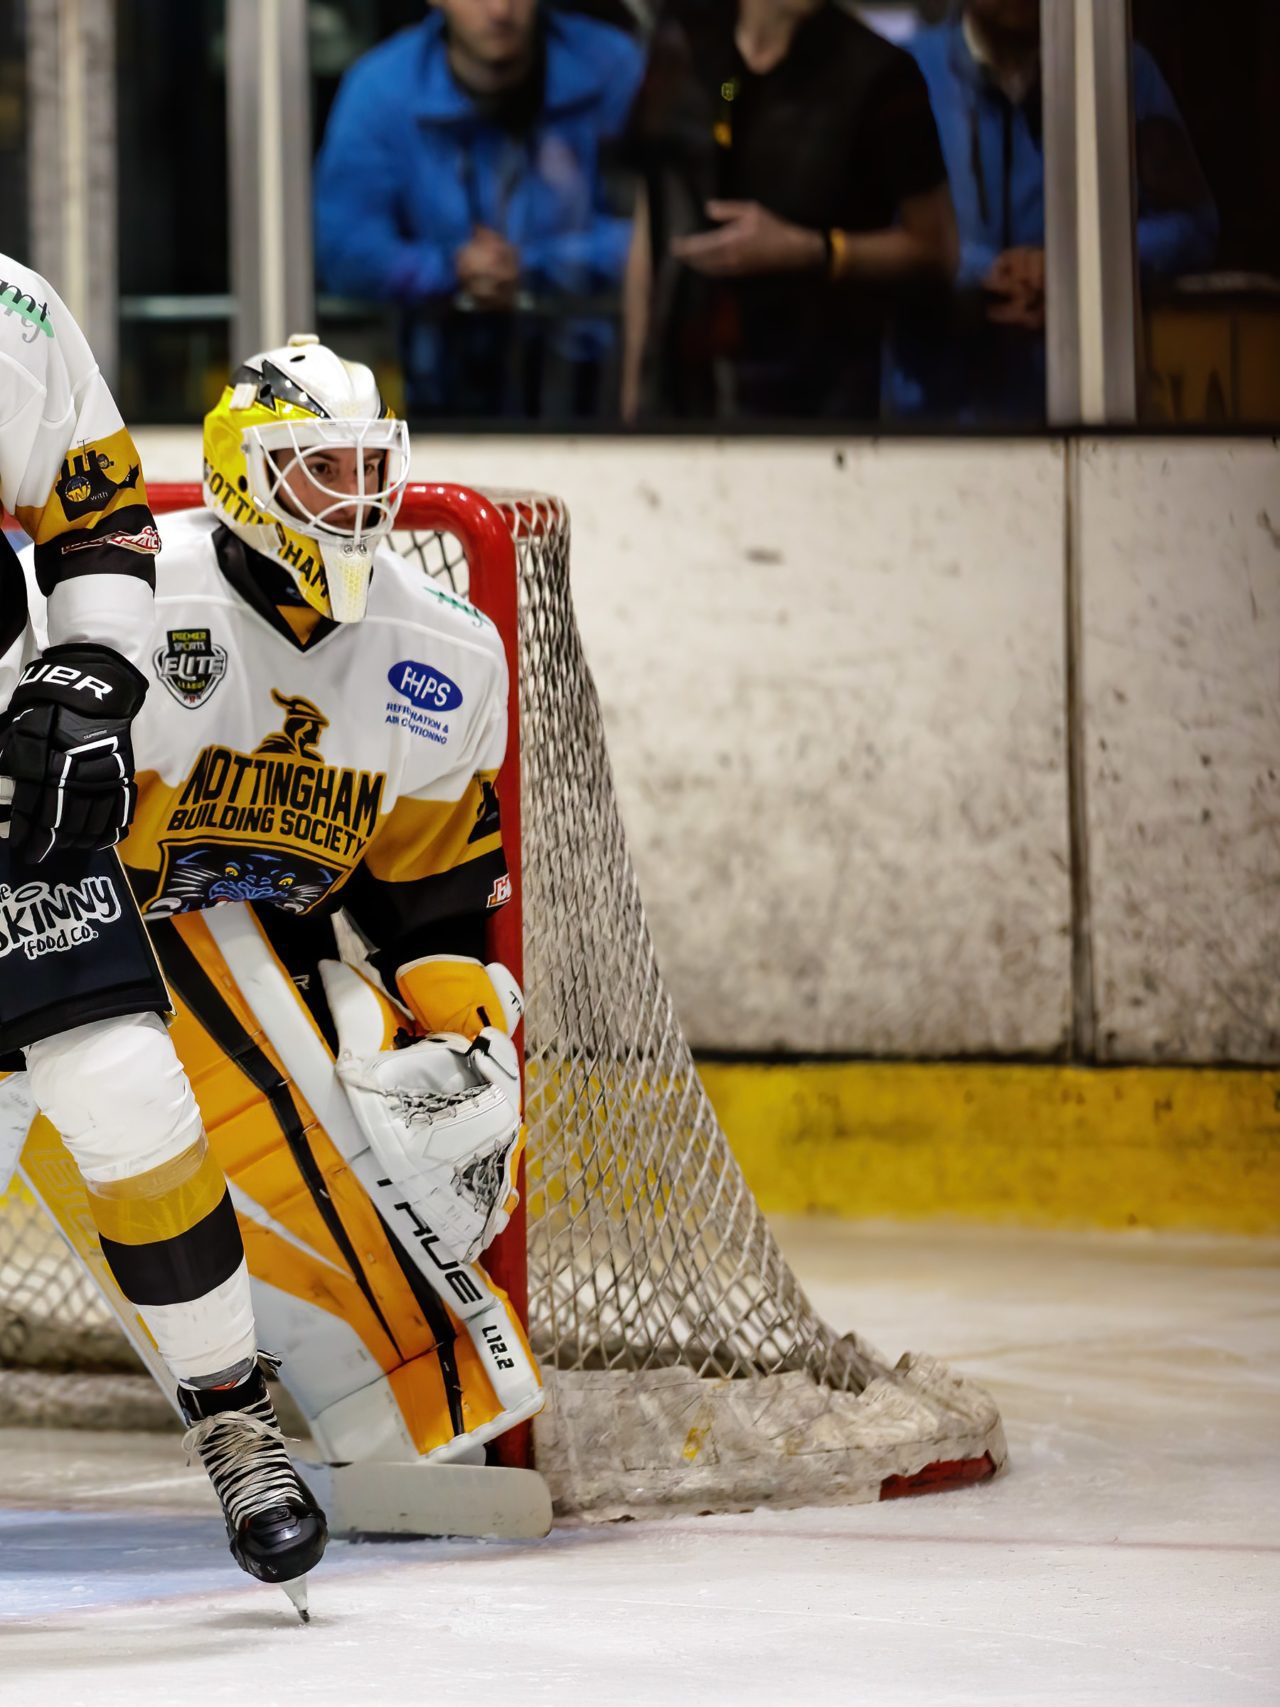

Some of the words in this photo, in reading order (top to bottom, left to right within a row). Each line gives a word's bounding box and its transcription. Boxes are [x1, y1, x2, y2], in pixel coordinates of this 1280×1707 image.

[161, 653, 224, 680] ELITE
[178, 748, 384, 838] NOTTINGHAM
[166, 802, 275, 834] BUILDING
[279, 809, 367, 860] SOCIETY
